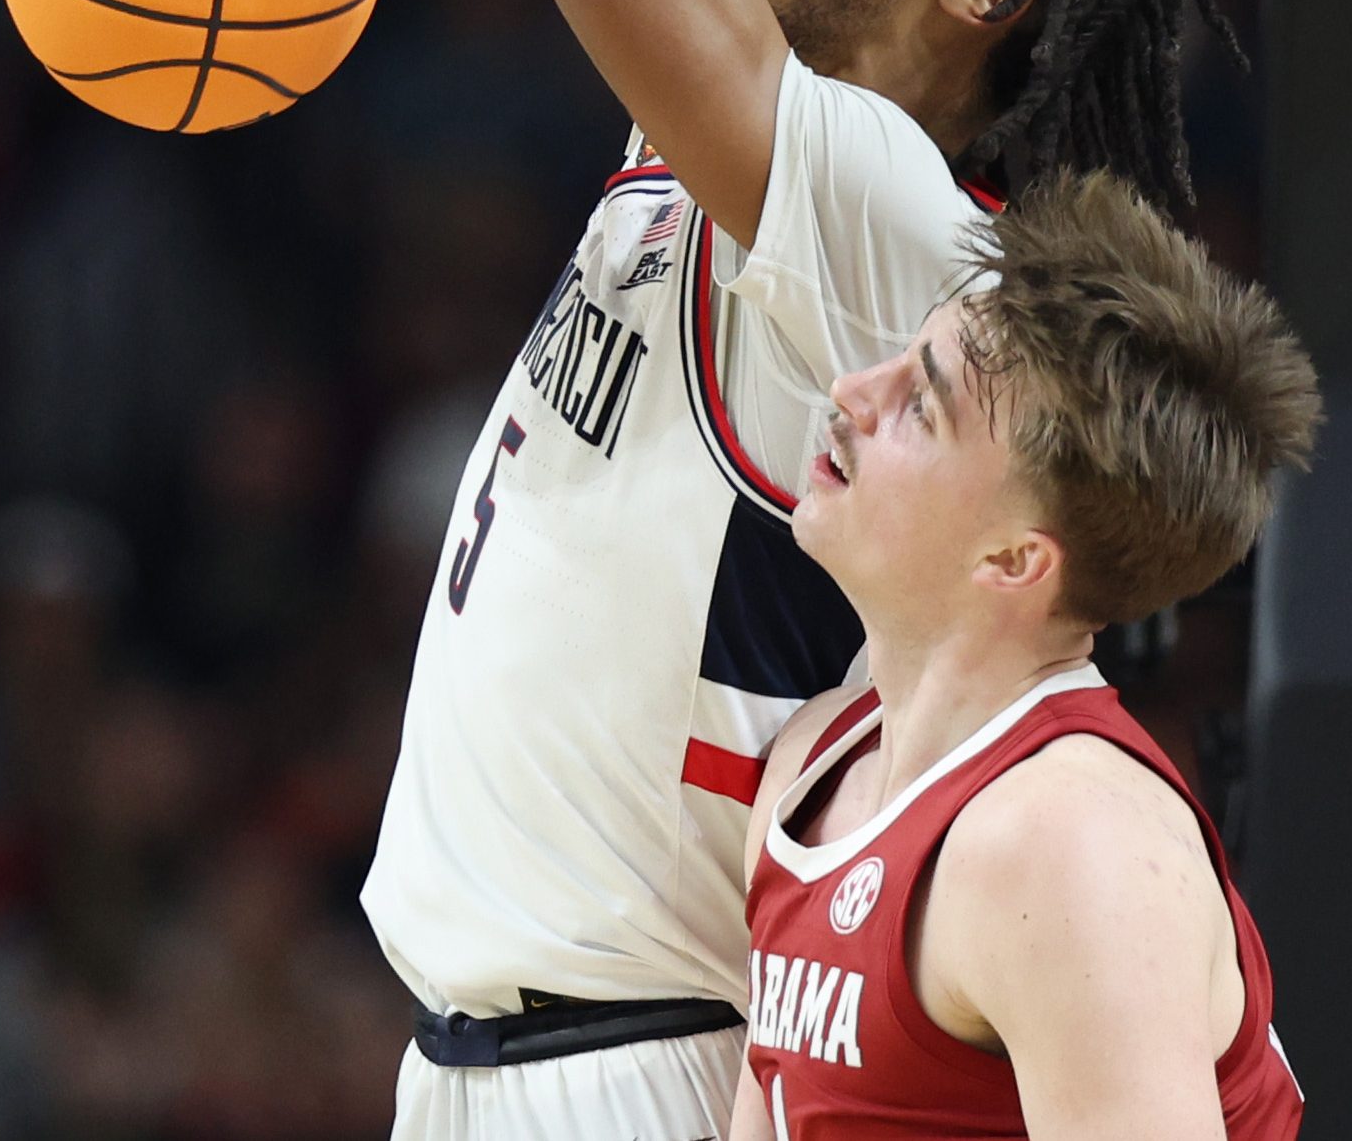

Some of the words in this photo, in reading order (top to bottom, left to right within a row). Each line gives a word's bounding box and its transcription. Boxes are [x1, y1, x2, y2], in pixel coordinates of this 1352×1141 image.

[626, 262, 673, 284] EAST
[637, 247, 667, 268] BIG
[449, 413, 527, 616] 5
[833, 863, 880, 927] SEC
